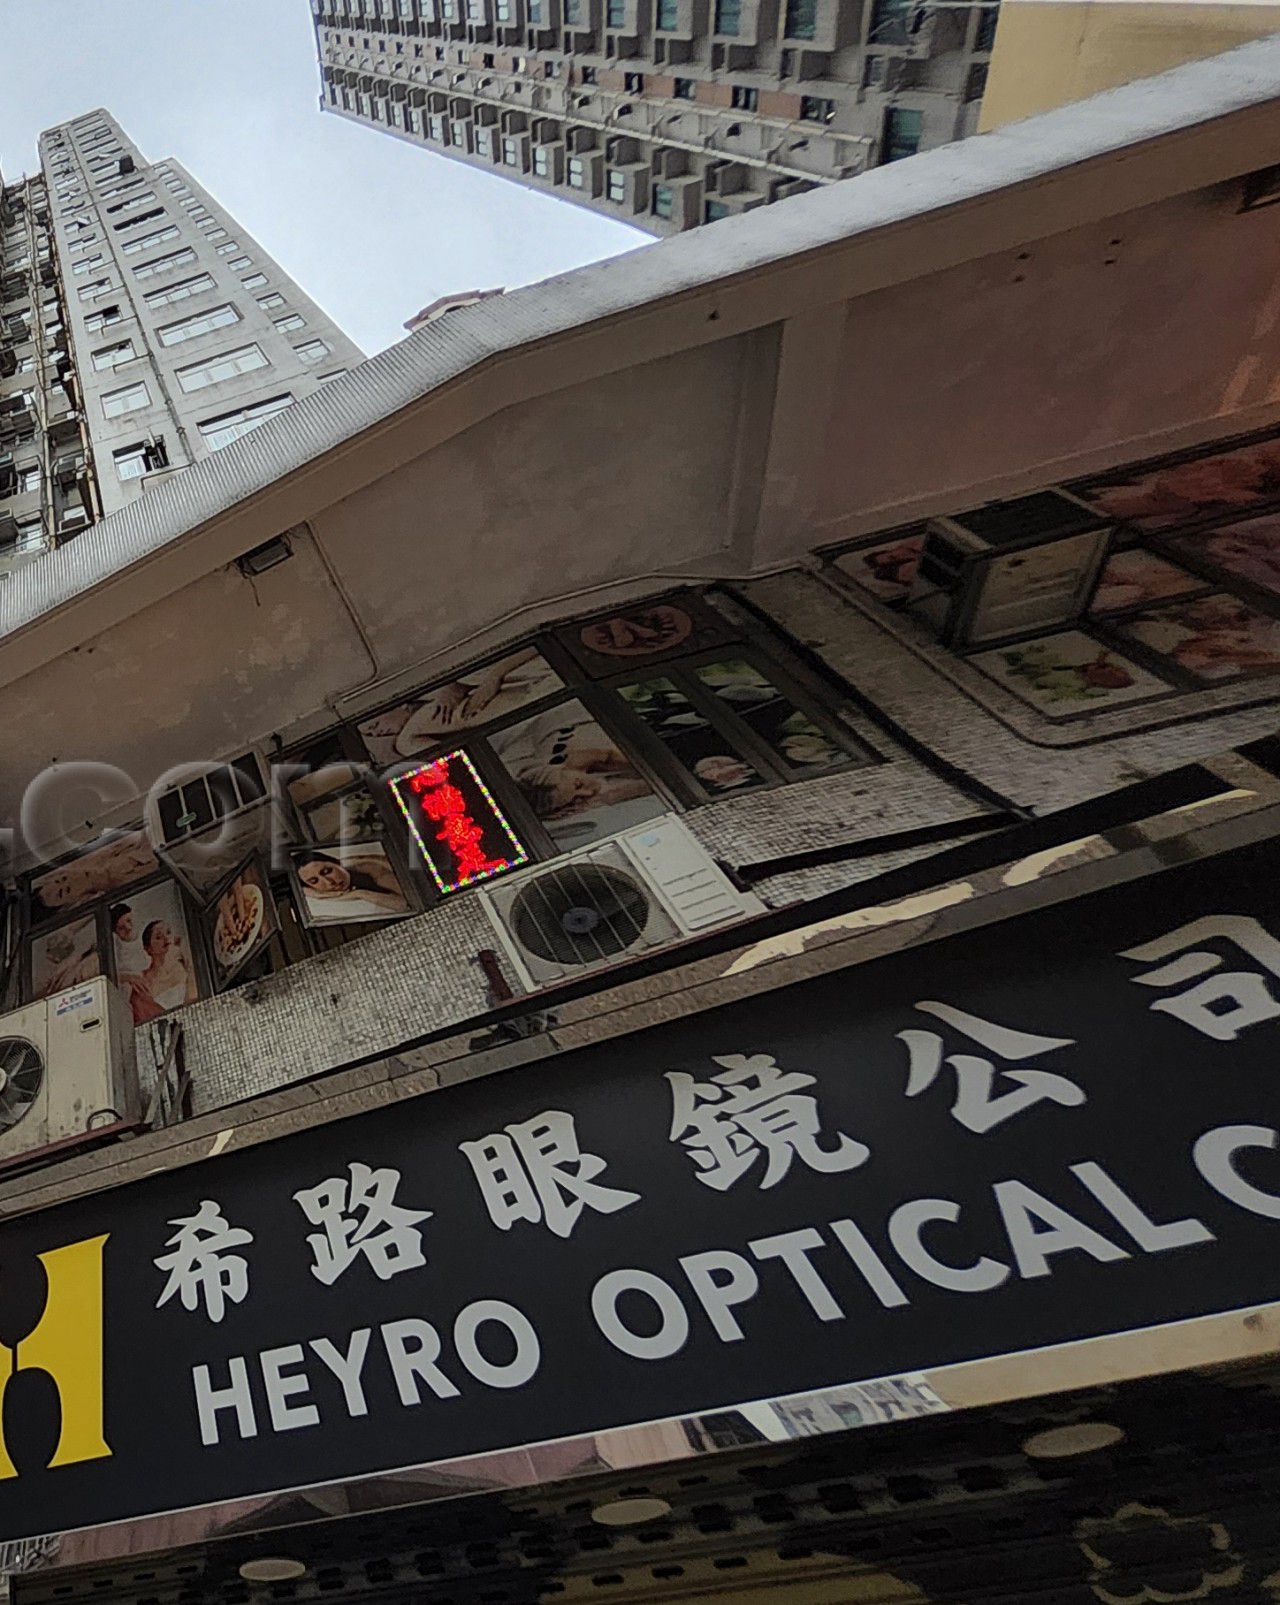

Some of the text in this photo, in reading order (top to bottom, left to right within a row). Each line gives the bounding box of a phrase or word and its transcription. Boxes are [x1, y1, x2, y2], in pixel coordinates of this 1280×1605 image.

[153, 913, 1280, 1323] 希路眼鏡公司
[190, 1299, 541, 1446] HEYRO
[590, 1160, 1218, 1361] OPTICAL
